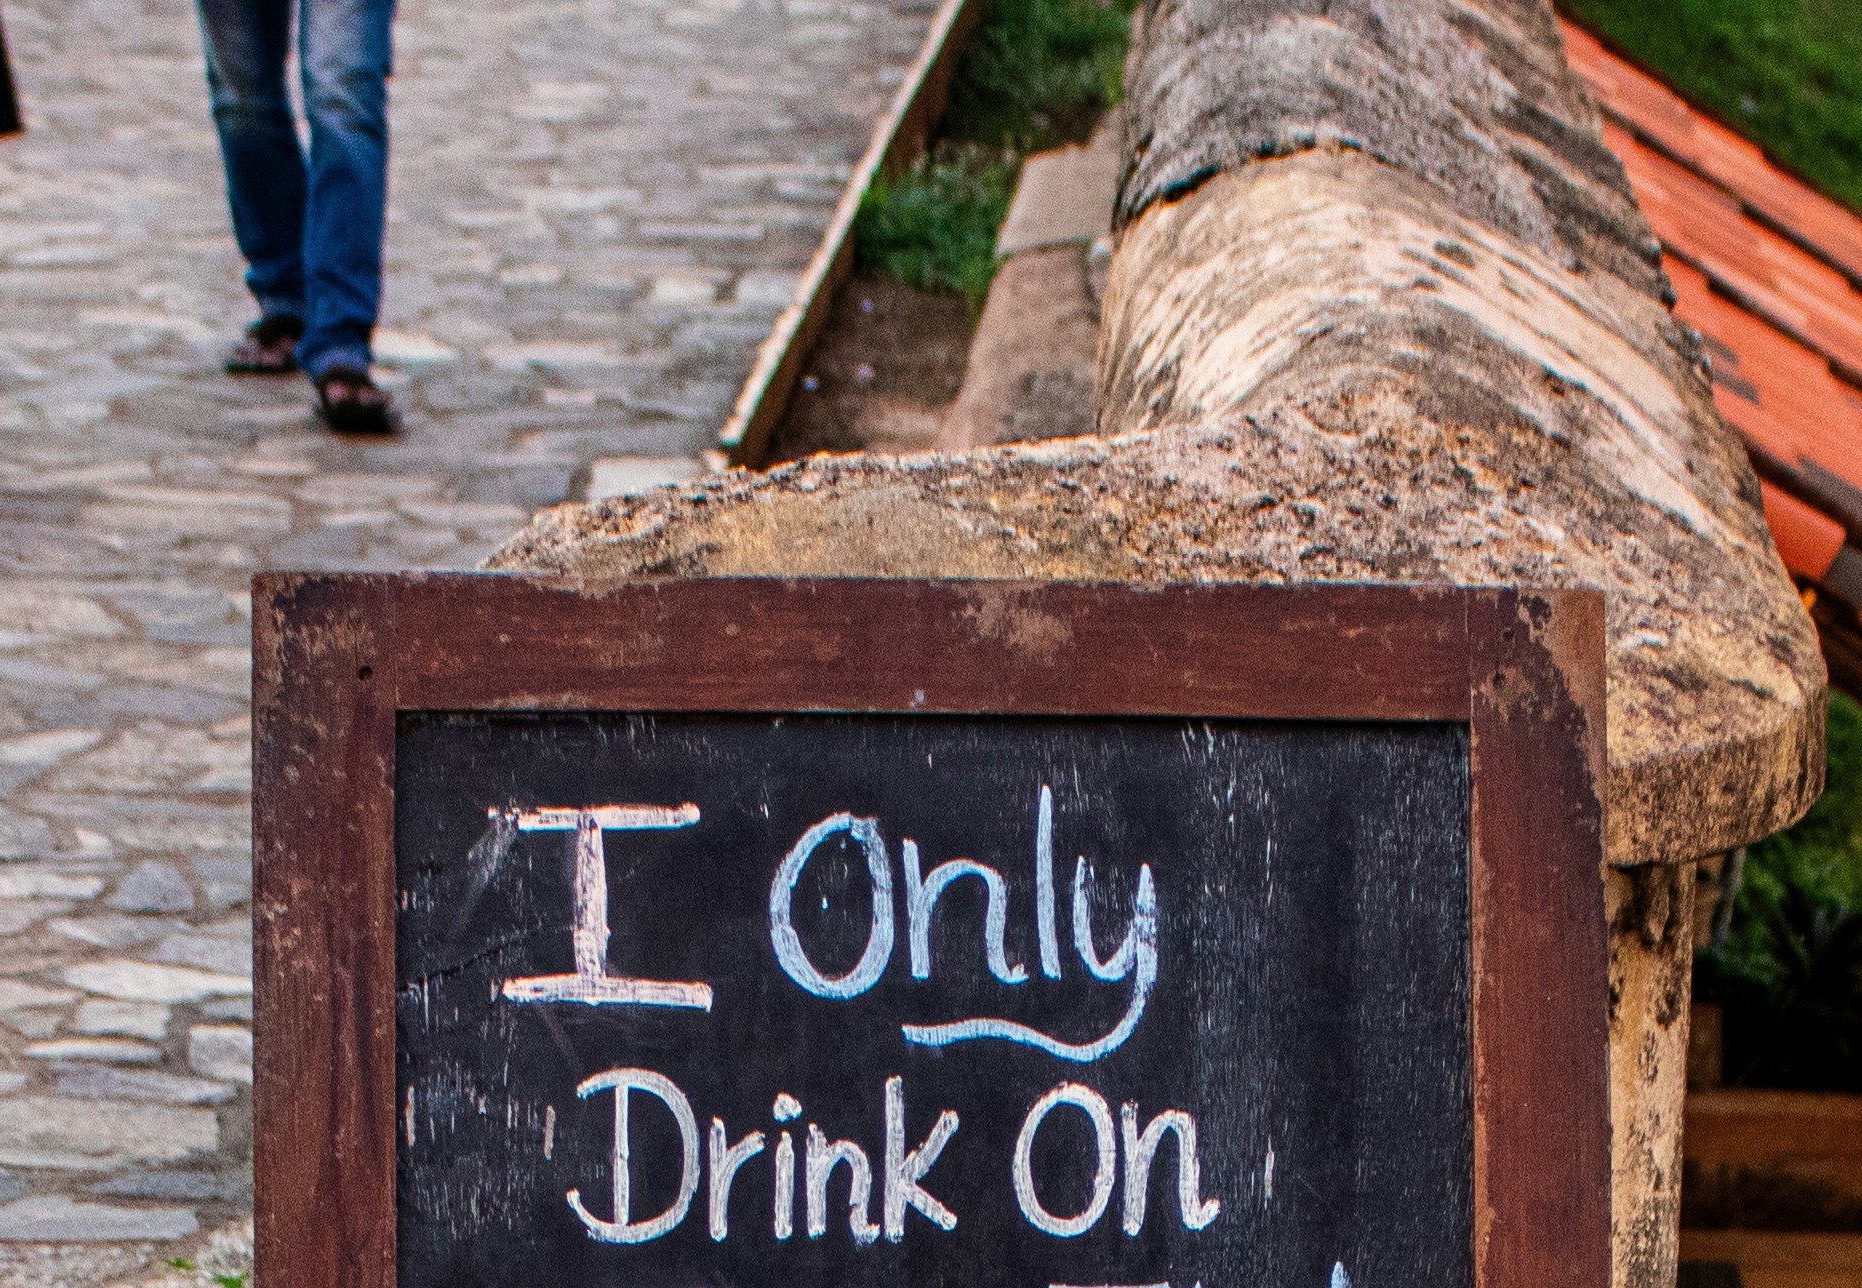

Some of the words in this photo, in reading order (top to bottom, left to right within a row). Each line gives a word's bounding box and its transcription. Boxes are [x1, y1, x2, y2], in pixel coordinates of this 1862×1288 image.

[492, 804, 714, 1010] I
[769, 784, 1161, 1061] Only
[566, 1068, 959, 1243] Drink
[1012, 1081, 1221, 1238] On
